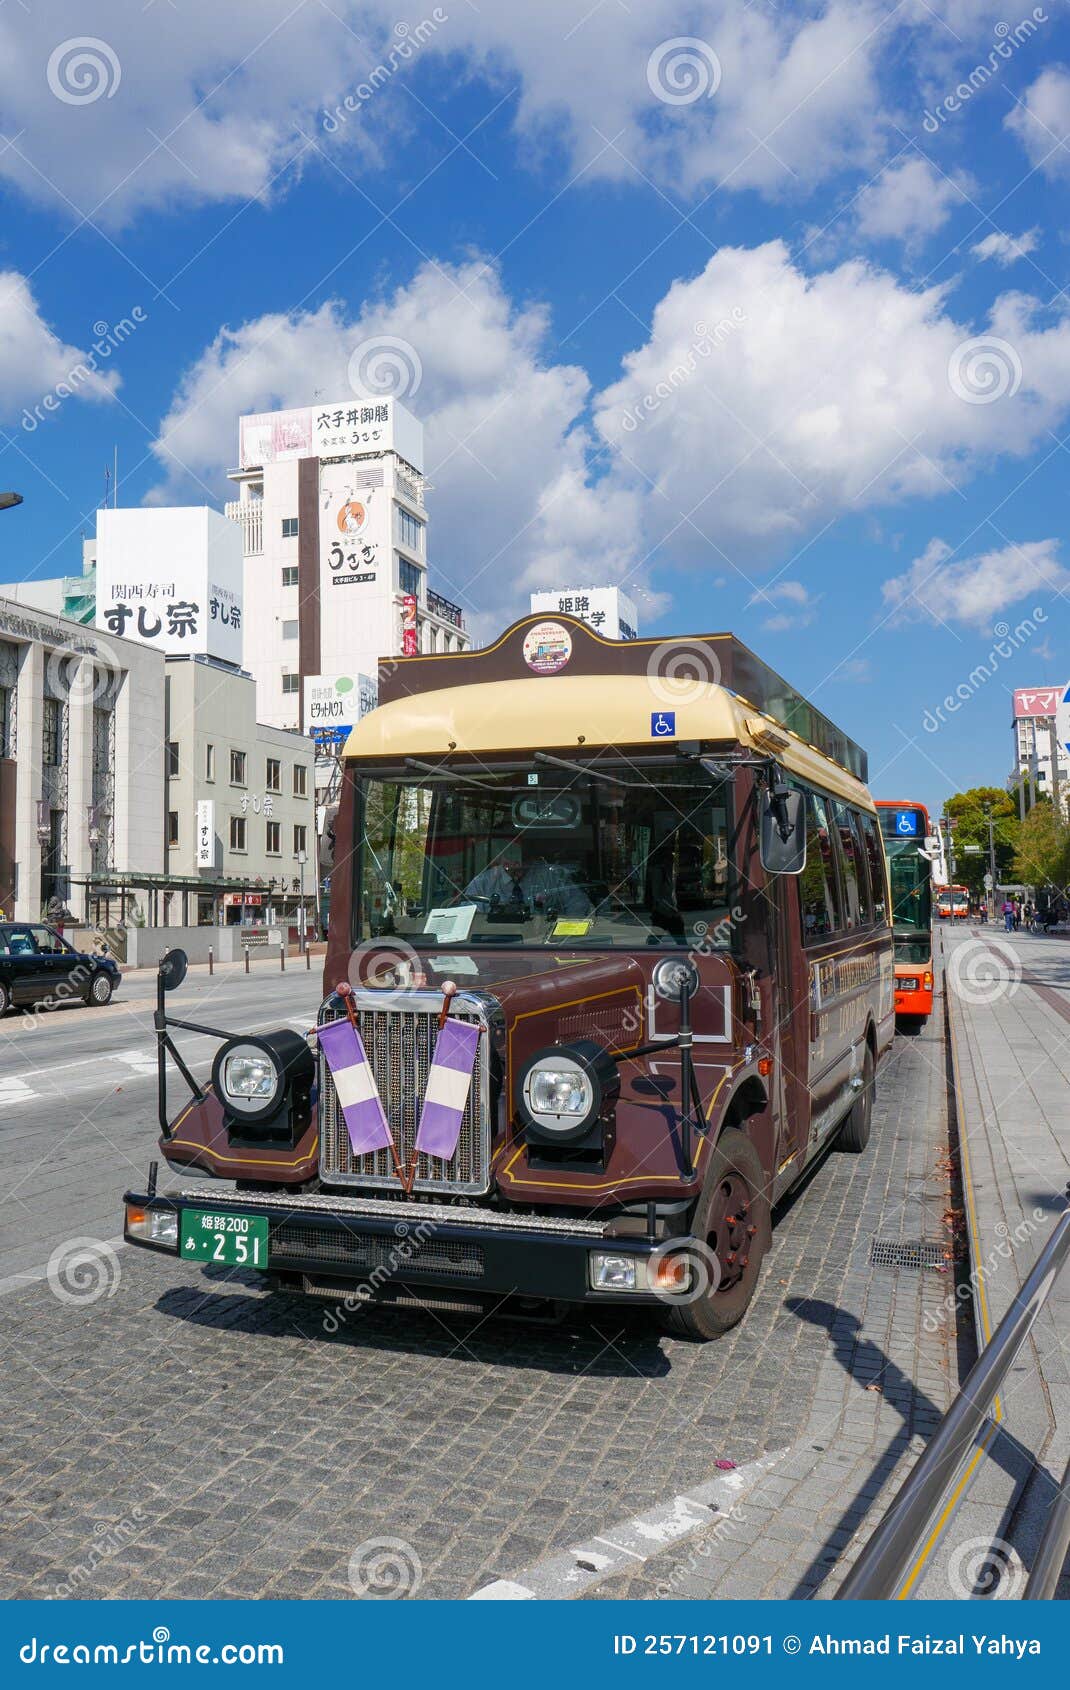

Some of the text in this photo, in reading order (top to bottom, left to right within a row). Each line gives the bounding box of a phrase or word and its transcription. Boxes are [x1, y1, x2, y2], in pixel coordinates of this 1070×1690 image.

[317, 403, 389, 430] 穴子丼御膳
[351, 429, 383, 445] うさぎ
[328, 541, 378, 571] うさぎ
[111, 583, 176, 599] 関西寿司
[209, 597, 241, 630] すし宗
[558, 596, 590, 613] 姫路
[103, 601, 199, 638] すし宗
[240, 793, 273, 818] すし宗
[200, 825, 209, 860] すし宗
[185, 1236, 196, 1250] あ
